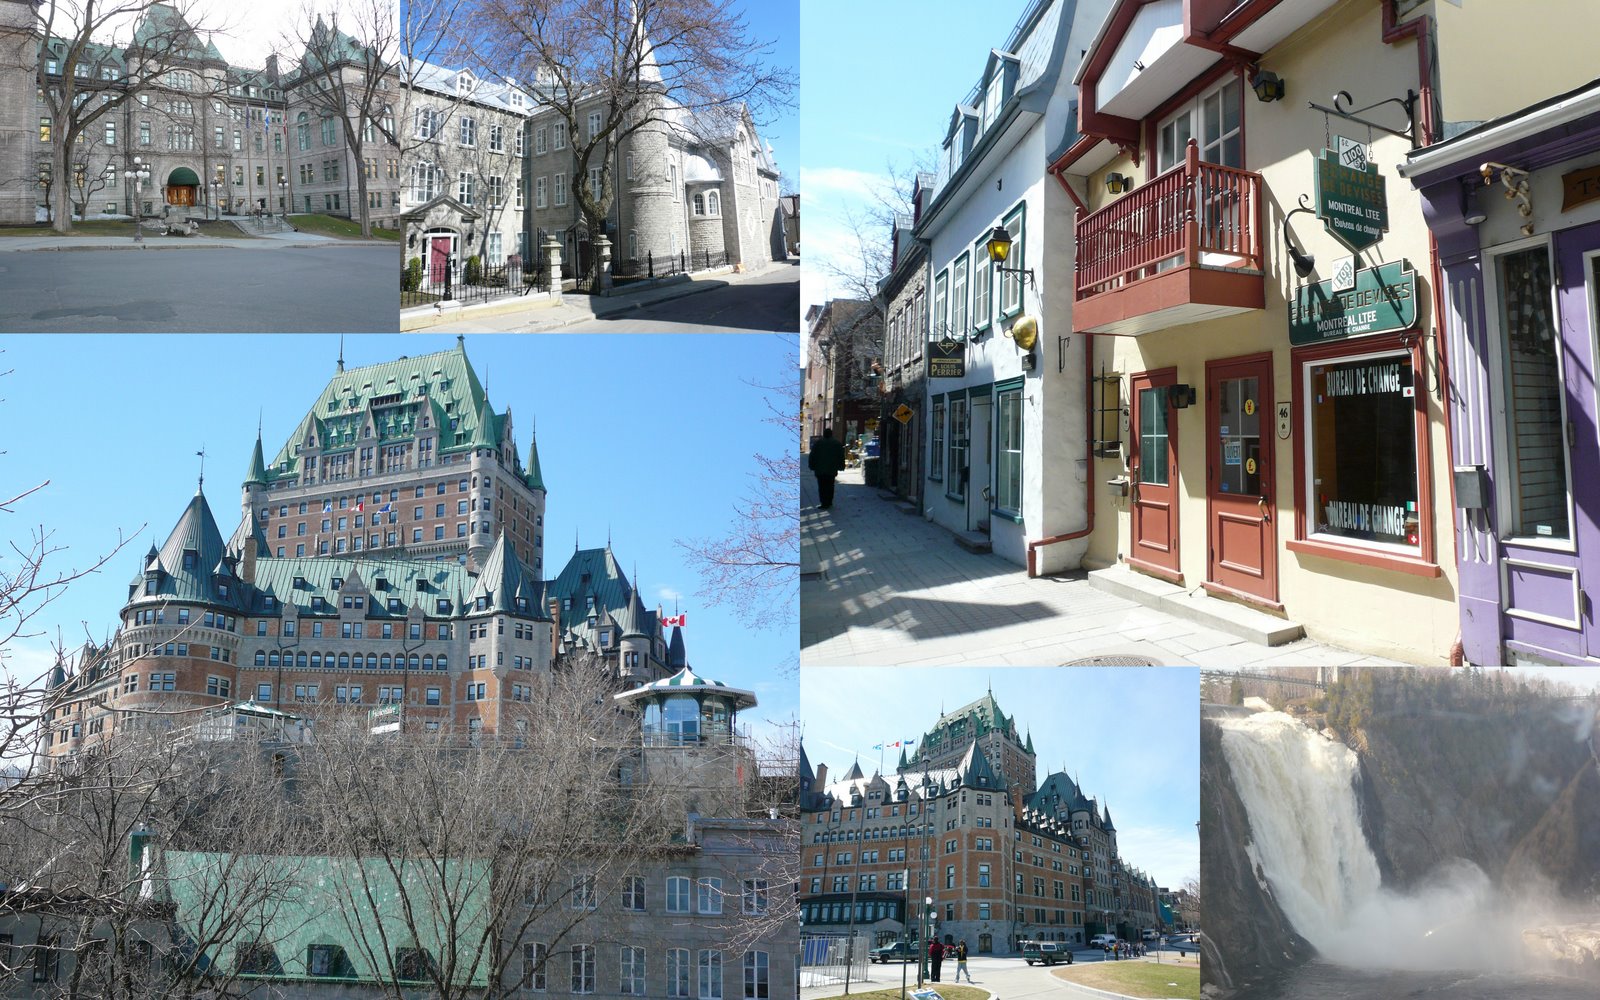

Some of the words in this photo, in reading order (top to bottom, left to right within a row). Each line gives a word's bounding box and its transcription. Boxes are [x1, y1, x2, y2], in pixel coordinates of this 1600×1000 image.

[1328, 200, 1363, 217] MONTREAL
[1365, 208, 1381, 221] LTEE
[1334, 217, 1355, 231] Bureau
[1356, 222, 1363, 232] de
[1357, 282, 1411, 307] DEVISES
[1317, 315, 1358, 332] MONTREAL
[1358, 310, 1377, 323] LTEE
[1323, 329, 1343, 338] BUREAU
[1351, 324, 1371, 333] CHANGE
[931, 364, 962, 376] PERRIER
[1326, 367, 1354, 397] BUREAU
[1356, 367, 1366, 395] DE
[1368, 363, 1400, 393] CHANGE
[1279, 407, 1288, 419] 46
[1328, 501, 1358, 529] BUREAU
[1359, 503, 1370, 531] DE
[1371, 505, 1405, 536] CHANGE
